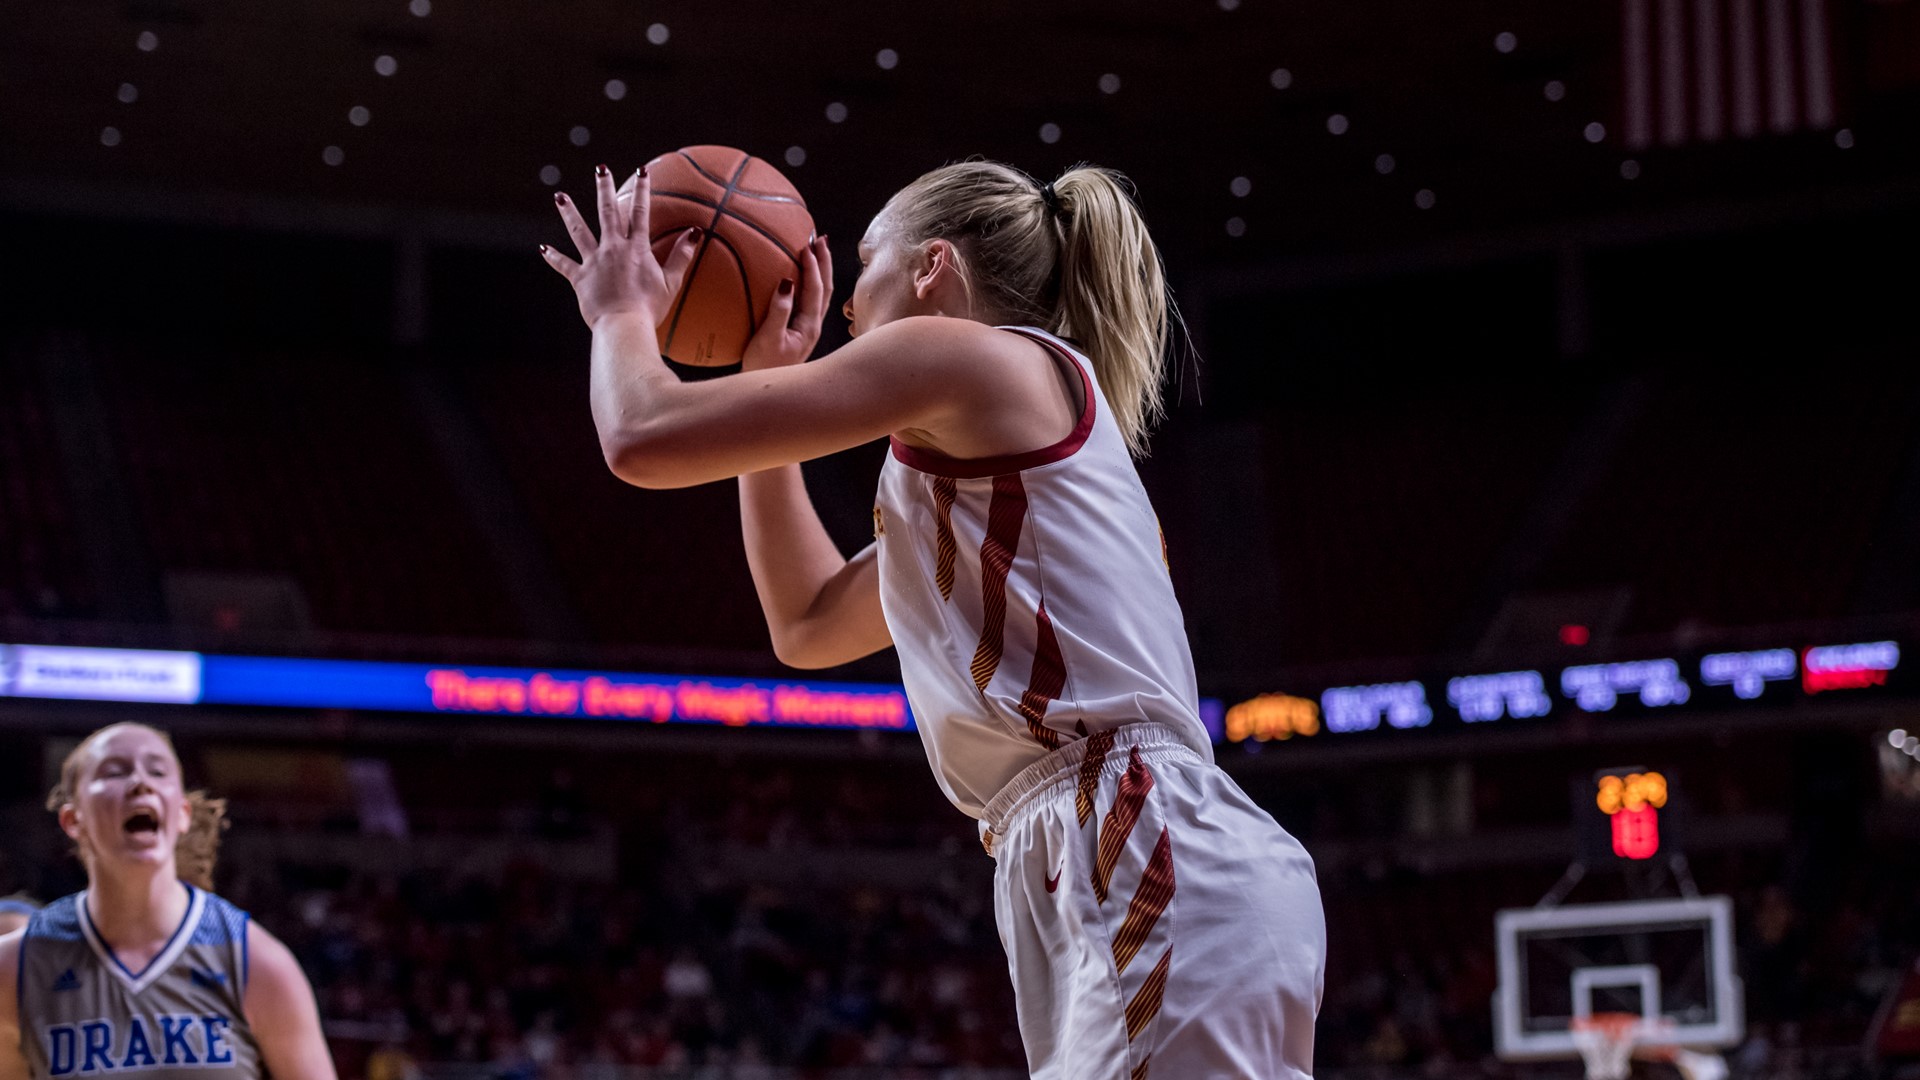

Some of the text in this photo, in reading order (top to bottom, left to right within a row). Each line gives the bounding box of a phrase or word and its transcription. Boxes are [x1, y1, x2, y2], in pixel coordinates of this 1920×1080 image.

[427, 670, 906, 728] There for Every Magic Moment
[48, 1014, 235, 1077] DRAKE
